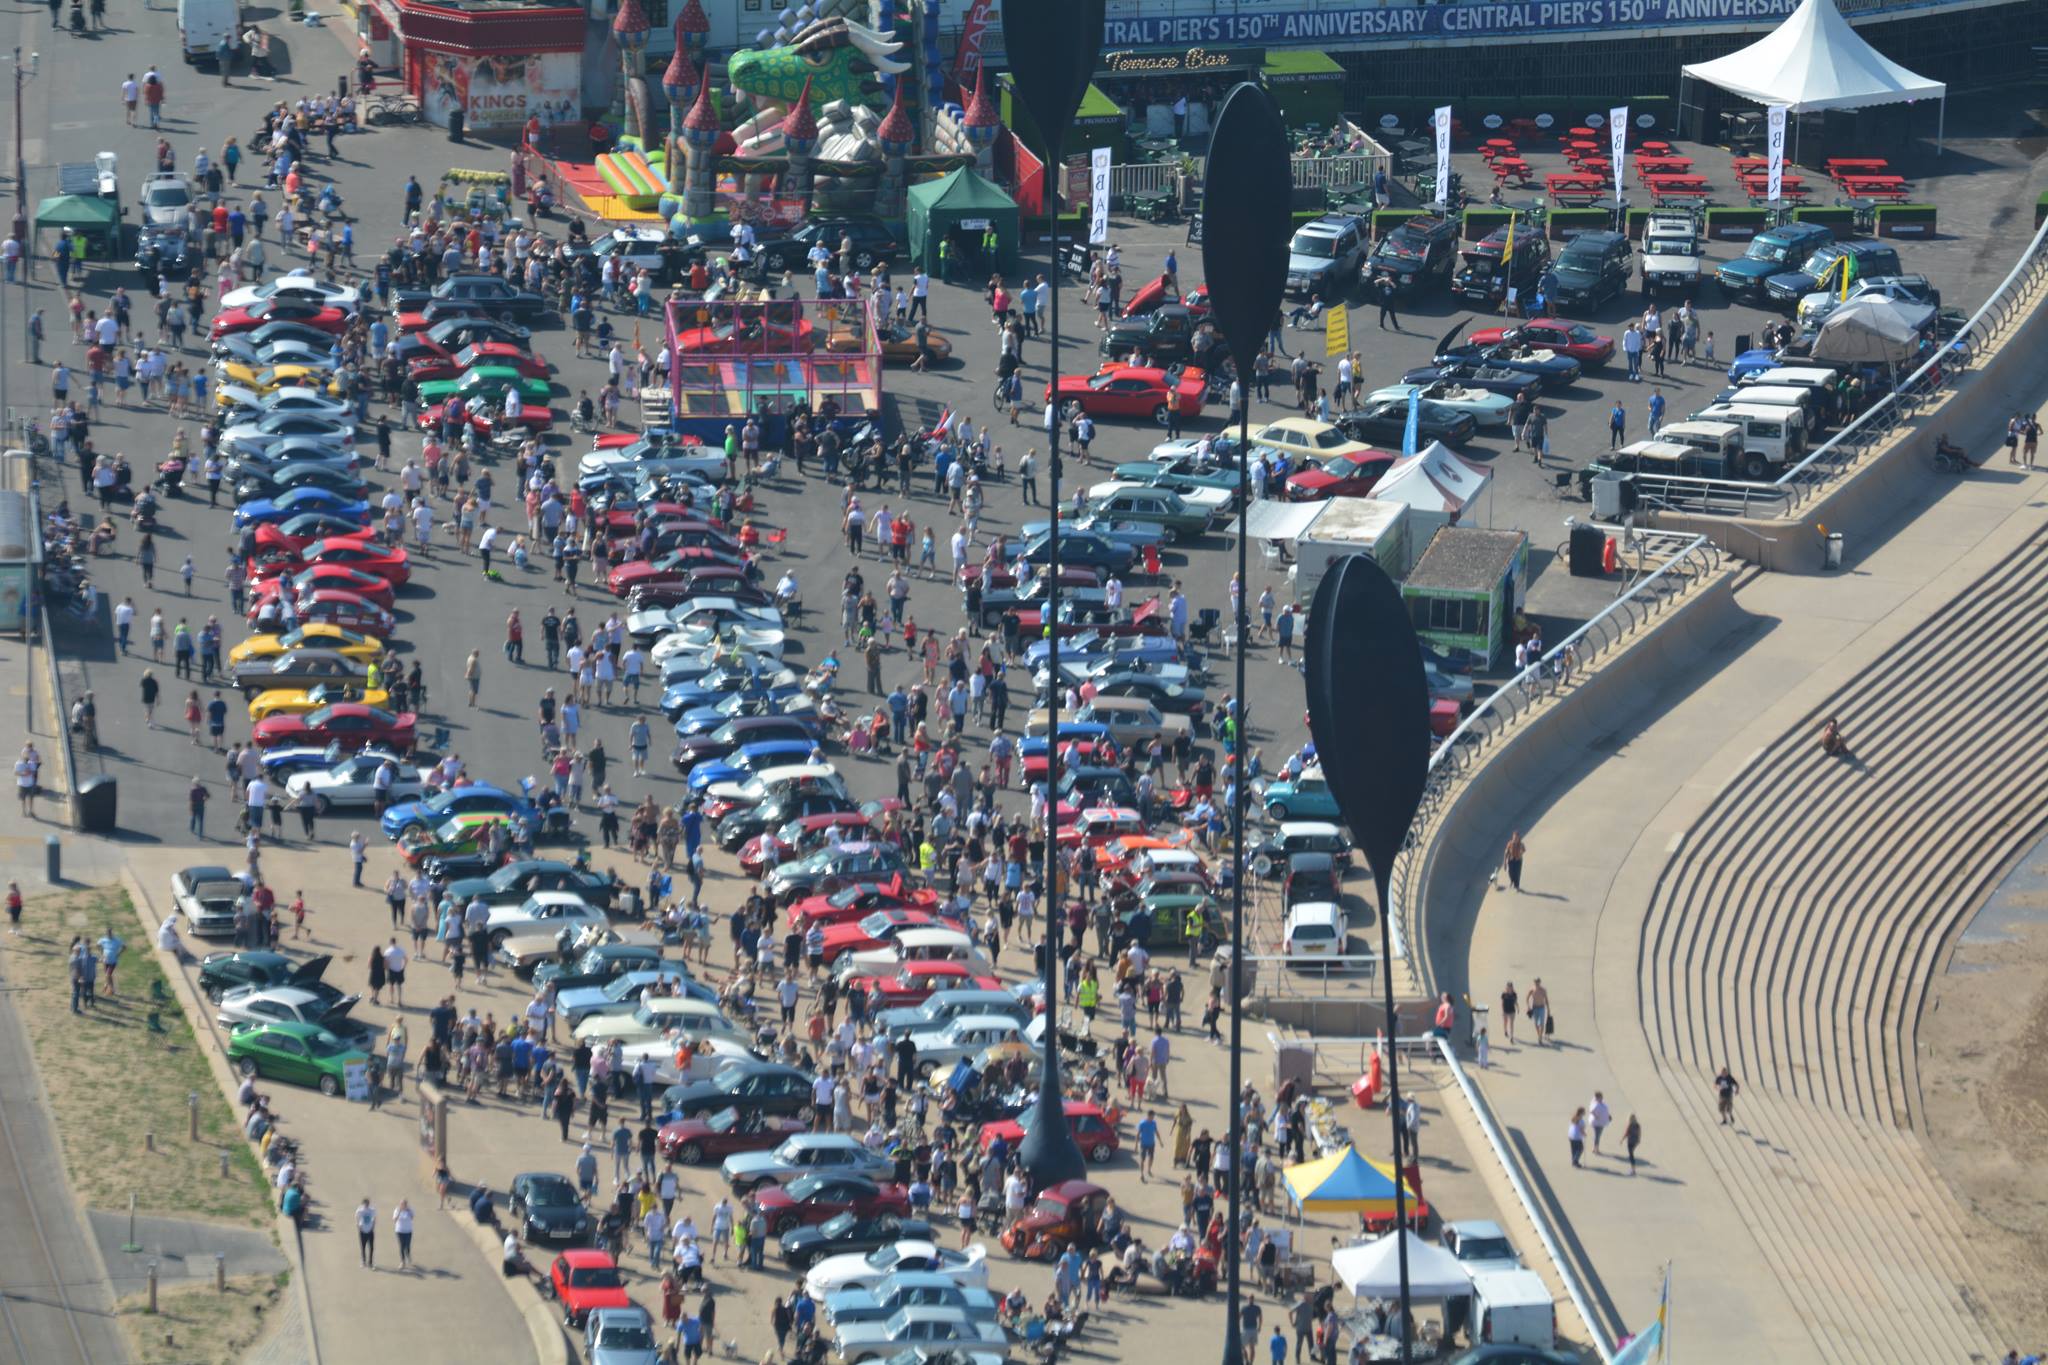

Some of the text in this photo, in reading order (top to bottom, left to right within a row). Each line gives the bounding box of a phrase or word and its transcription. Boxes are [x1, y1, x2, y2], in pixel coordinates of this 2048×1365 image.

[1159, 17, 1220, 42] PIER'S
[1226, 14, 1280, 40] 150TH
[1283, 9, 1429, 37] ANNIVERSARY
[1442, 4, 1535, 31] CENTRAL
[1540, 1, 1603, 26] PIER'S
[1608, 0, 1661, 21] 150TH
[1665, 0, 1799, 20] ANNIVERSAR
[1105, 47, 1230, 72] Terrace Bar
[470, 95, 527, 109] KINGS
[1067, 261, 1083, 272] OPEN
